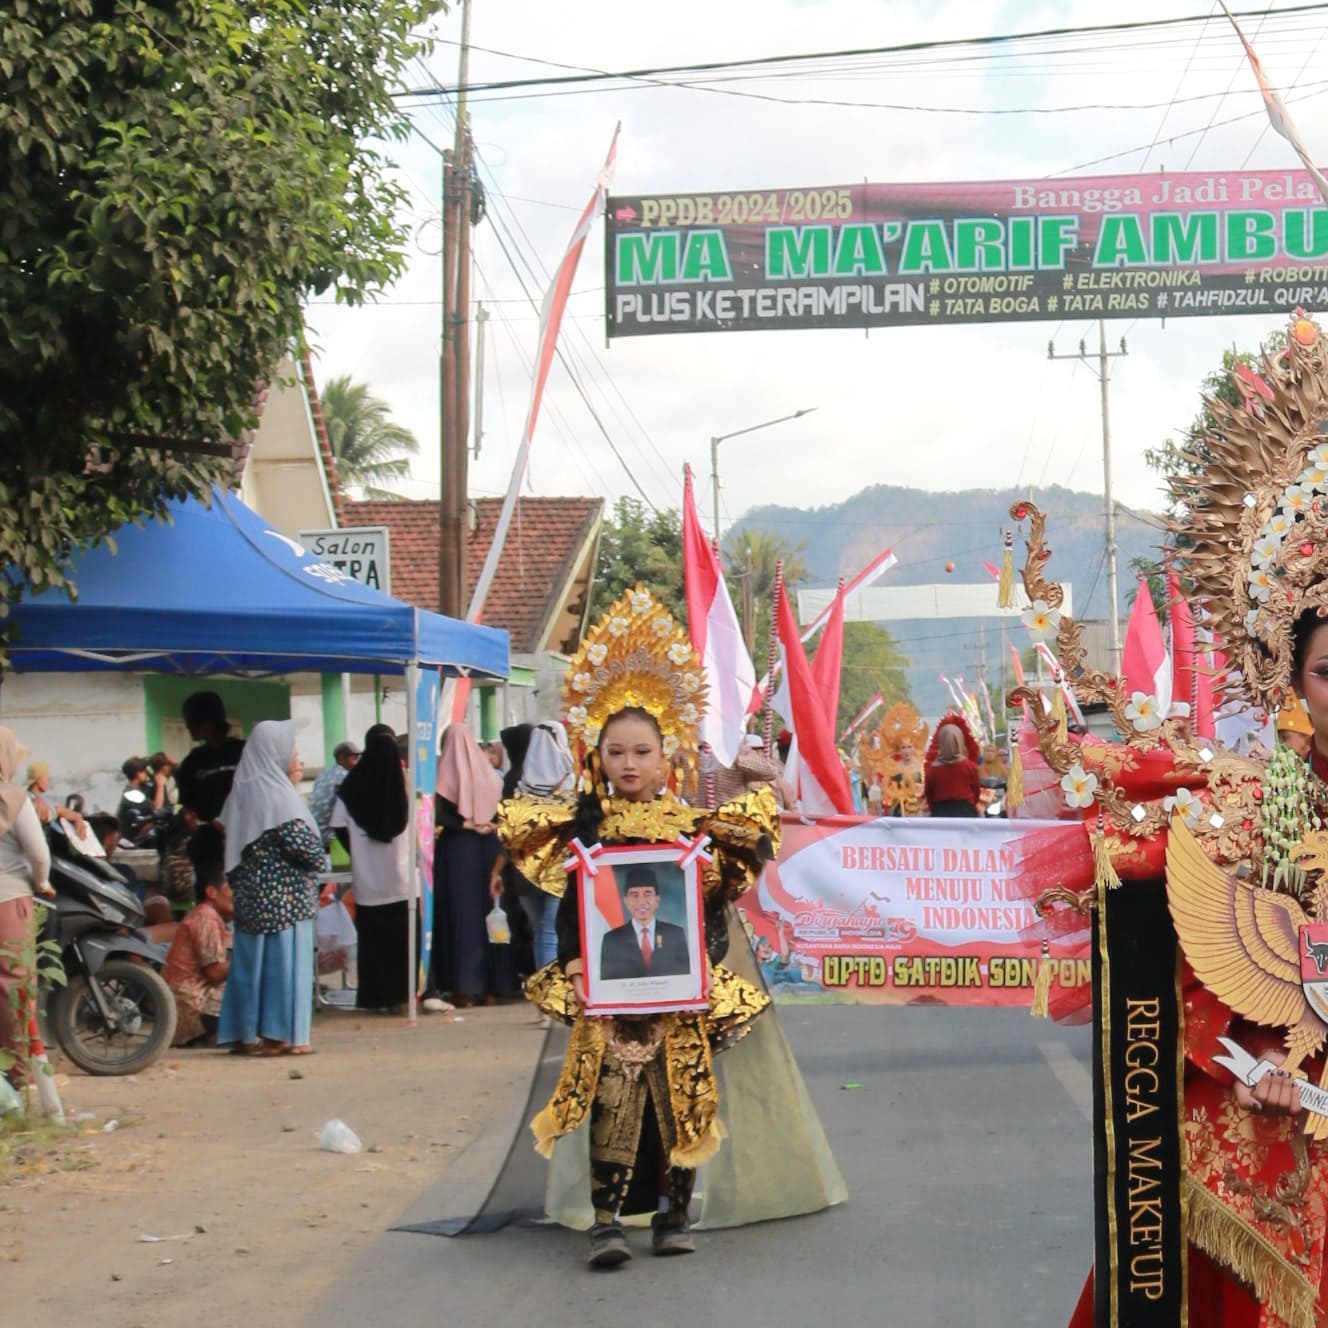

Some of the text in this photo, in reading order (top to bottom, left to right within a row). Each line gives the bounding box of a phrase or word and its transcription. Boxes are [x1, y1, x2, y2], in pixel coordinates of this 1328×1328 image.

[641, 189, 852, 227] PPDB 2024/2025
[1012, 185, 1142, 213] Bangga
[1152, 177, 1229, 204] Jadi
[615, 228, 734, 287] MA
[764, 214, 1079, 280] MA'ARIF
[944, 275, 1035, 294] OTOMOTIF
[1077, 270, 1201, 290] ELEKTRONIKA
[616, 283, 925, 323] PLUS KETERAMPILAN
[944, 298, 985, 315] TATA
[989, 296, 1040, 314] BOGA
[1063, 294, 1104, 311] TATA
[1108, 293, 1150, 310] RIAS
[1173, 288, 1269, 308] TAHFIDZUL
[312, 537, 375, 556] Salon
[841, 845, 1015, 873] BERSATU DALAM
[905, 876, 983, 904] MENUJU
[923, 906, 1036, 930] INDONESIA
[823, 956, 887, 987] UPTD
[894, 956, 982, 988] SATDIK
[989, 957, 1037, 987] SDN
[1125, 997, 1160, 1123] REGGA
